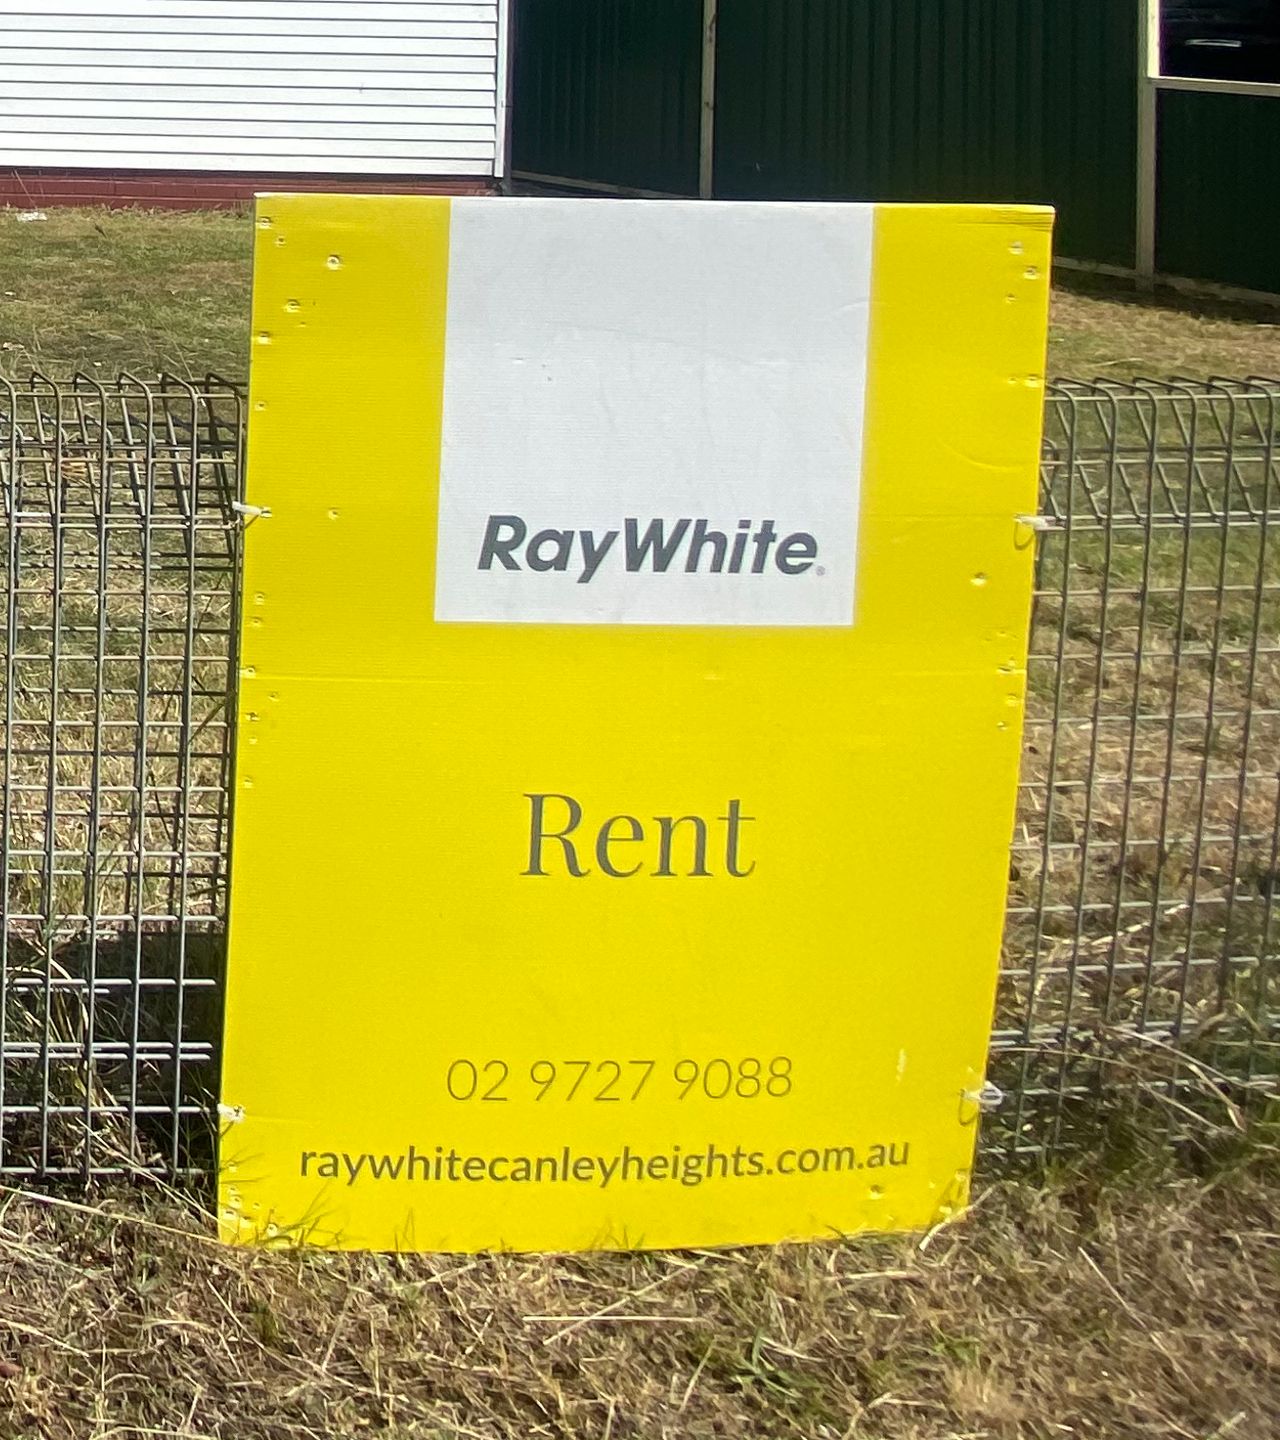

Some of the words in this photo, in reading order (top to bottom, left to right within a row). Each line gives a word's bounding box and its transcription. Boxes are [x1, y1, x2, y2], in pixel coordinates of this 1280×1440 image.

[519, 792, 757, 878] Rent
[446, 1058, 510, 1102] 02
[529, 1059, 656, 1102] 9727
[672, 1055, 794, 1100] 9088
[299, 1141, 912, 1187] raywhitecanleyheights.com.au
